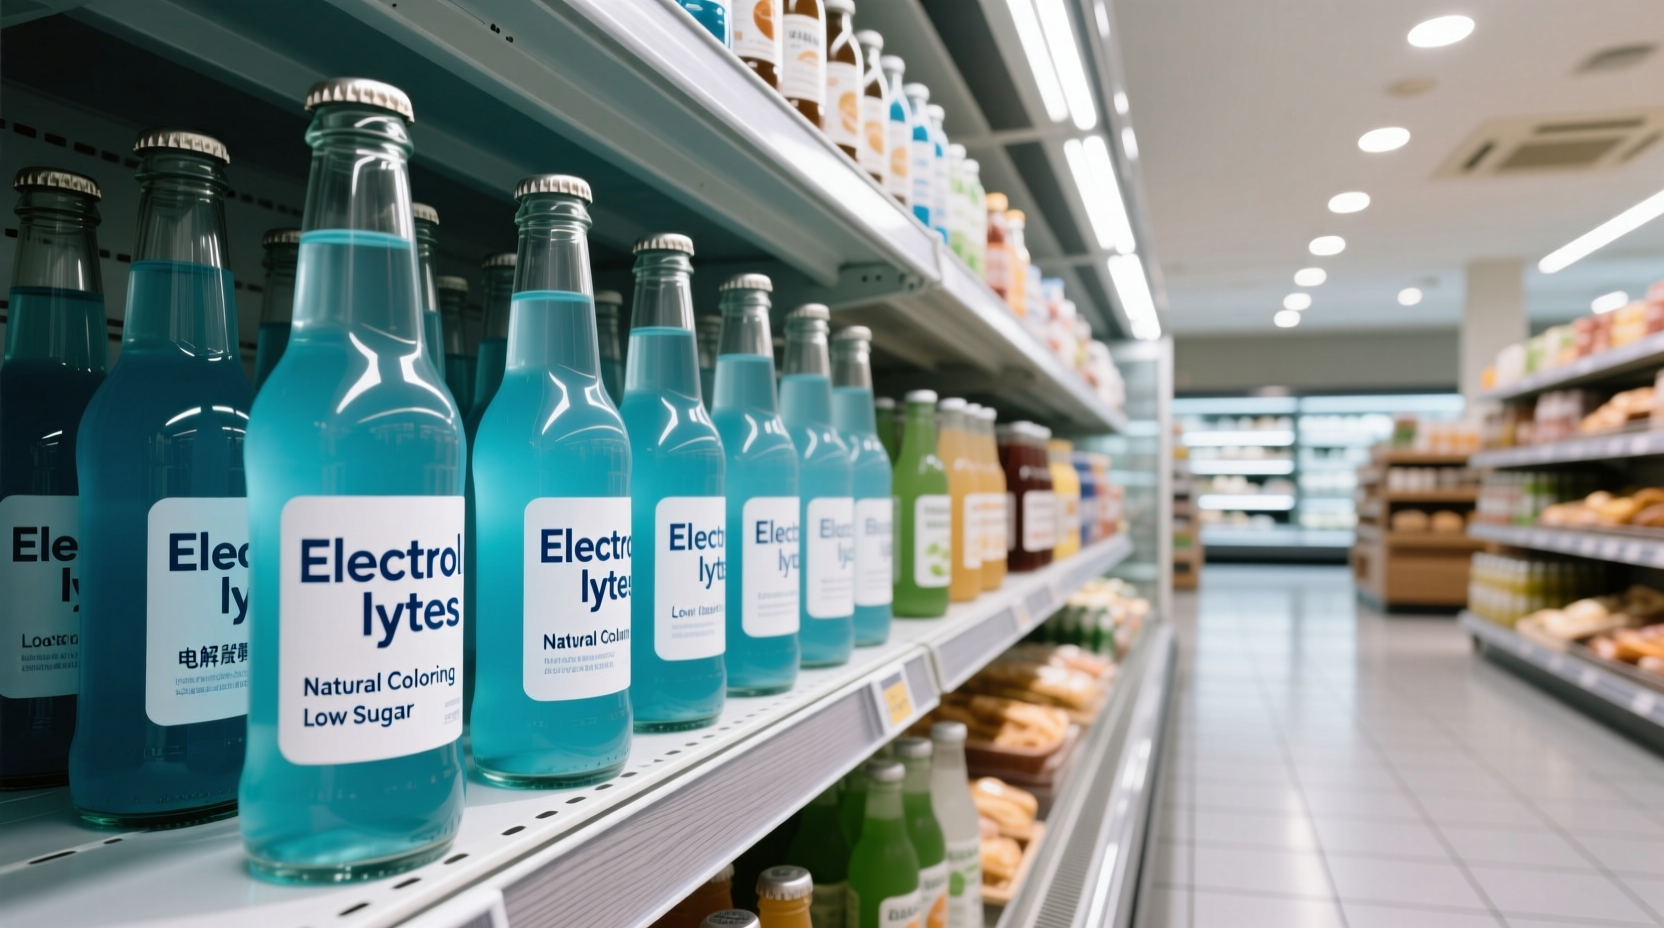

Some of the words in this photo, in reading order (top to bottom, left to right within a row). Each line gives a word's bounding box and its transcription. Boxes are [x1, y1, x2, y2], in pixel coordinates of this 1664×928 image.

[300, 533, 462, 584] Electrol
[362, 591, 460, 649] lytes
[543, 630, 597, 651] Natural
[303, 672, 382, 697] Natural
[387, 664, 456, 692] Coloring
[303, 707, 348, 728] Low
[353, 702, 415, 728] Sugar
